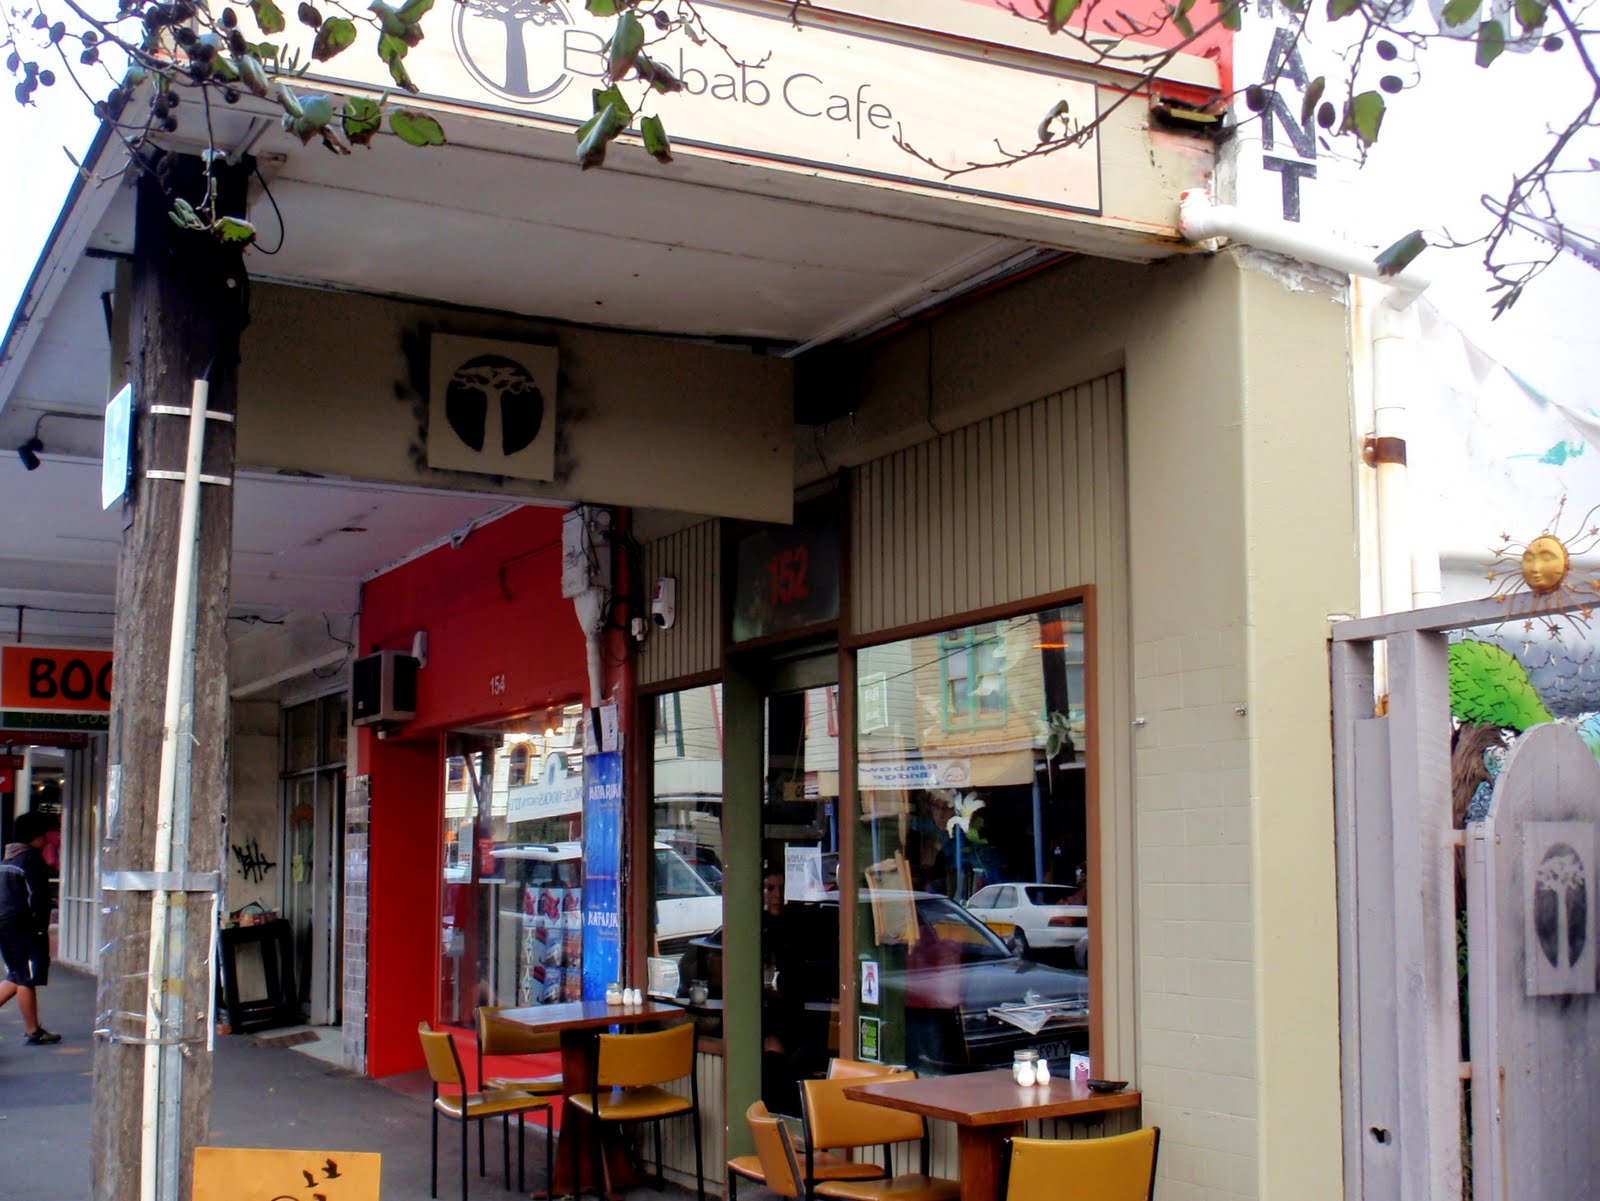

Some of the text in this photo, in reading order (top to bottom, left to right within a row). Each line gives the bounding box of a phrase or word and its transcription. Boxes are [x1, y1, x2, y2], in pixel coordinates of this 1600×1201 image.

[562, 29, 893, 140] Bbab Cafe
[1257, 0, 1317, 223] ANT
[490, 674, 505, 695] 154
